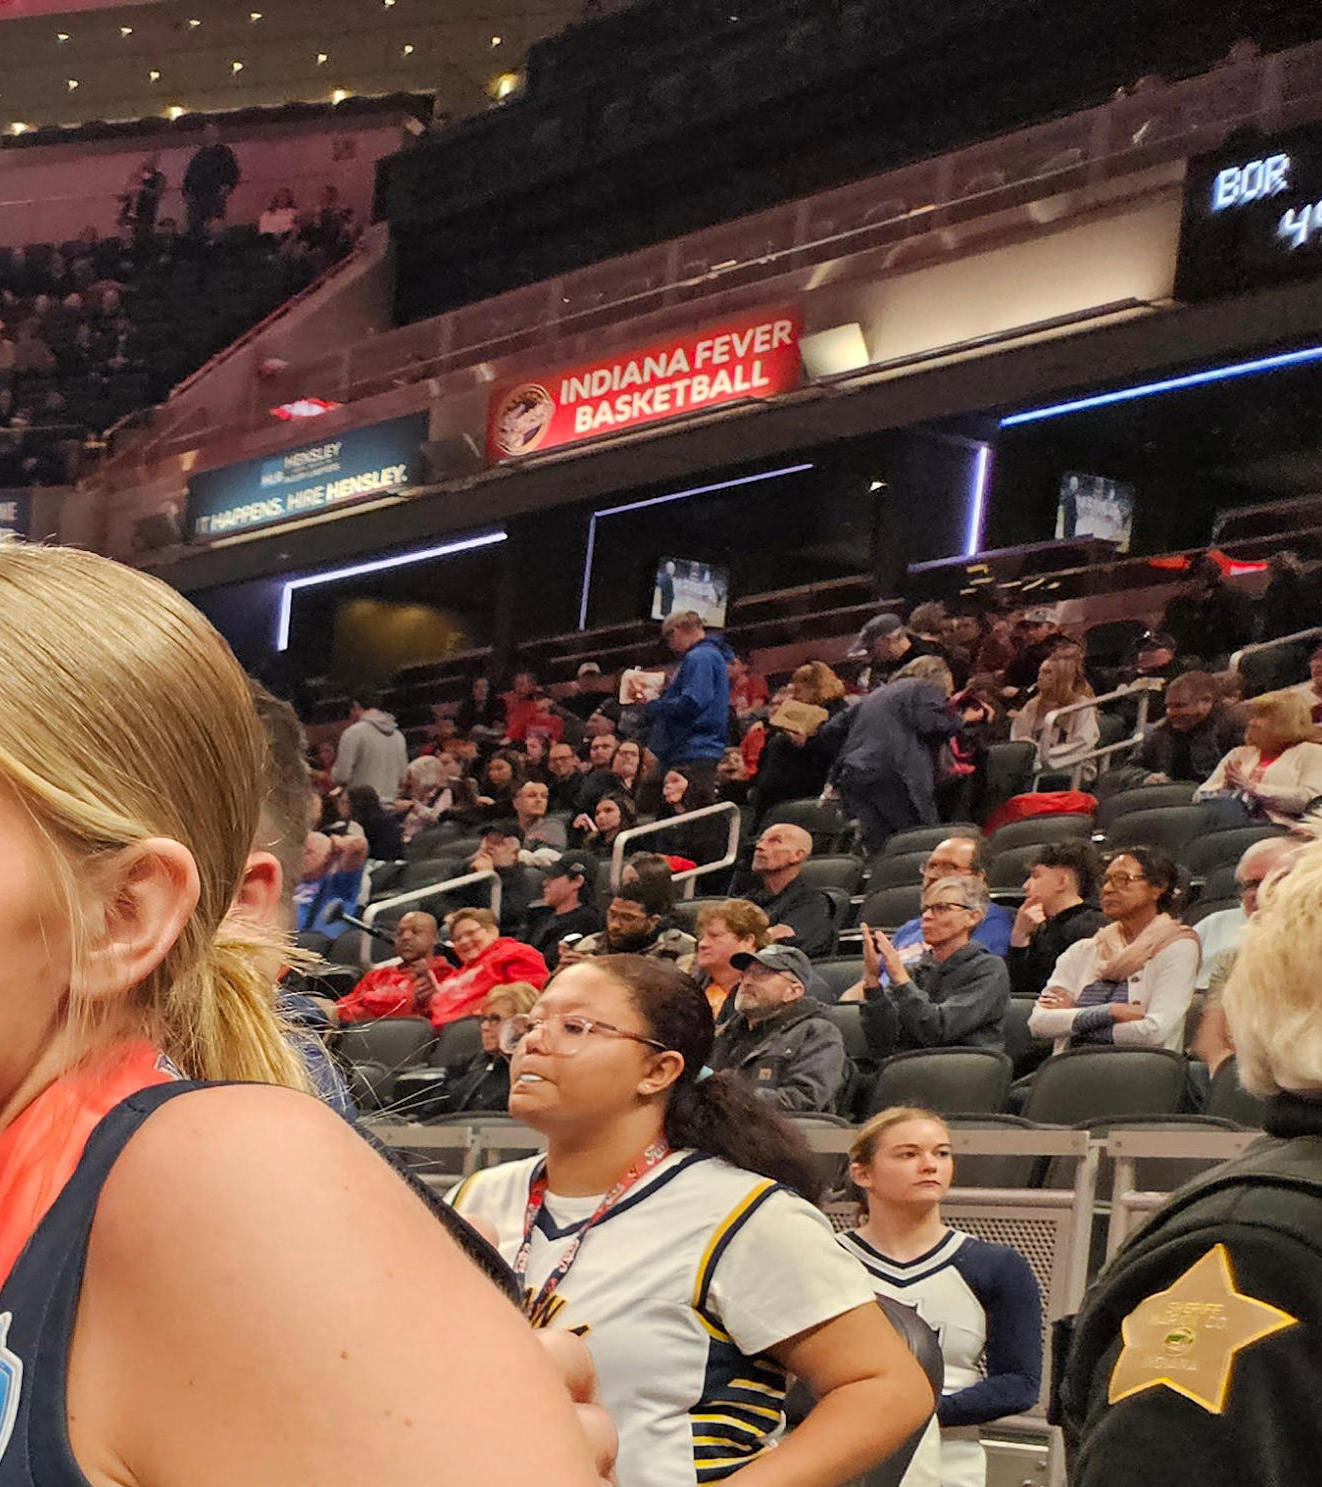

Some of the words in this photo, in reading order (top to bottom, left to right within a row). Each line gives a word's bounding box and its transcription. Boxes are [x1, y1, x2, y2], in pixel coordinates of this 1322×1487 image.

[1210, 153, 1290, 212] BOR
[560, 348, 691, 406] INDIANA
[695, 319, 793, 370] FEVER
[574, 361, 770, 433] BASKETBALL
[287, 485, 325, 510] HIRE
[325, 464, 408, 501] HENSLEY.
